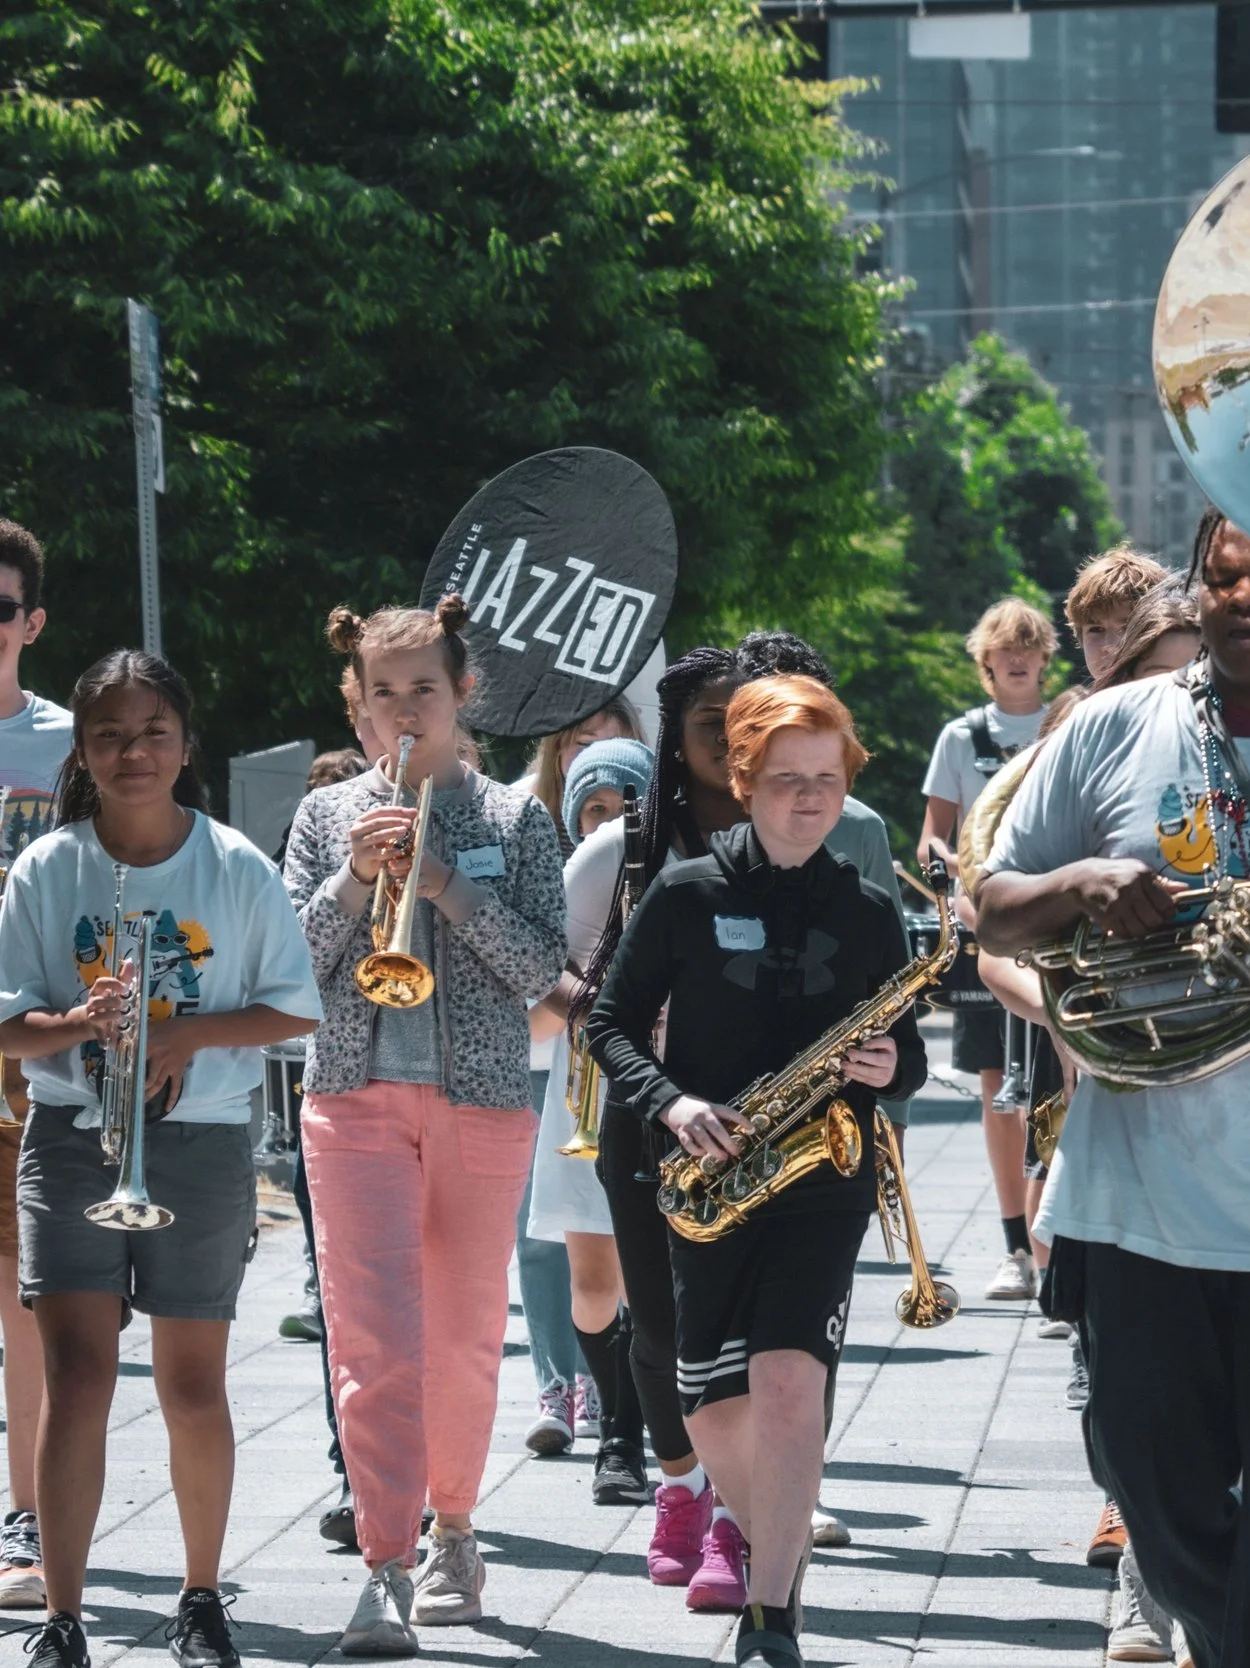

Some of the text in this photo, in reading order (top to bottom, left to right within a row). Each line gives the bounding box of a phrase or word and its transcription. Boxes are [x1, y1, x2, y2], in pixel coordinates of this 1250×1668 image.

[446, 523, 482, 592] SEATTLE
[466, 858, 494, 870] Josie
[725, 926, 746, 941] Ian
